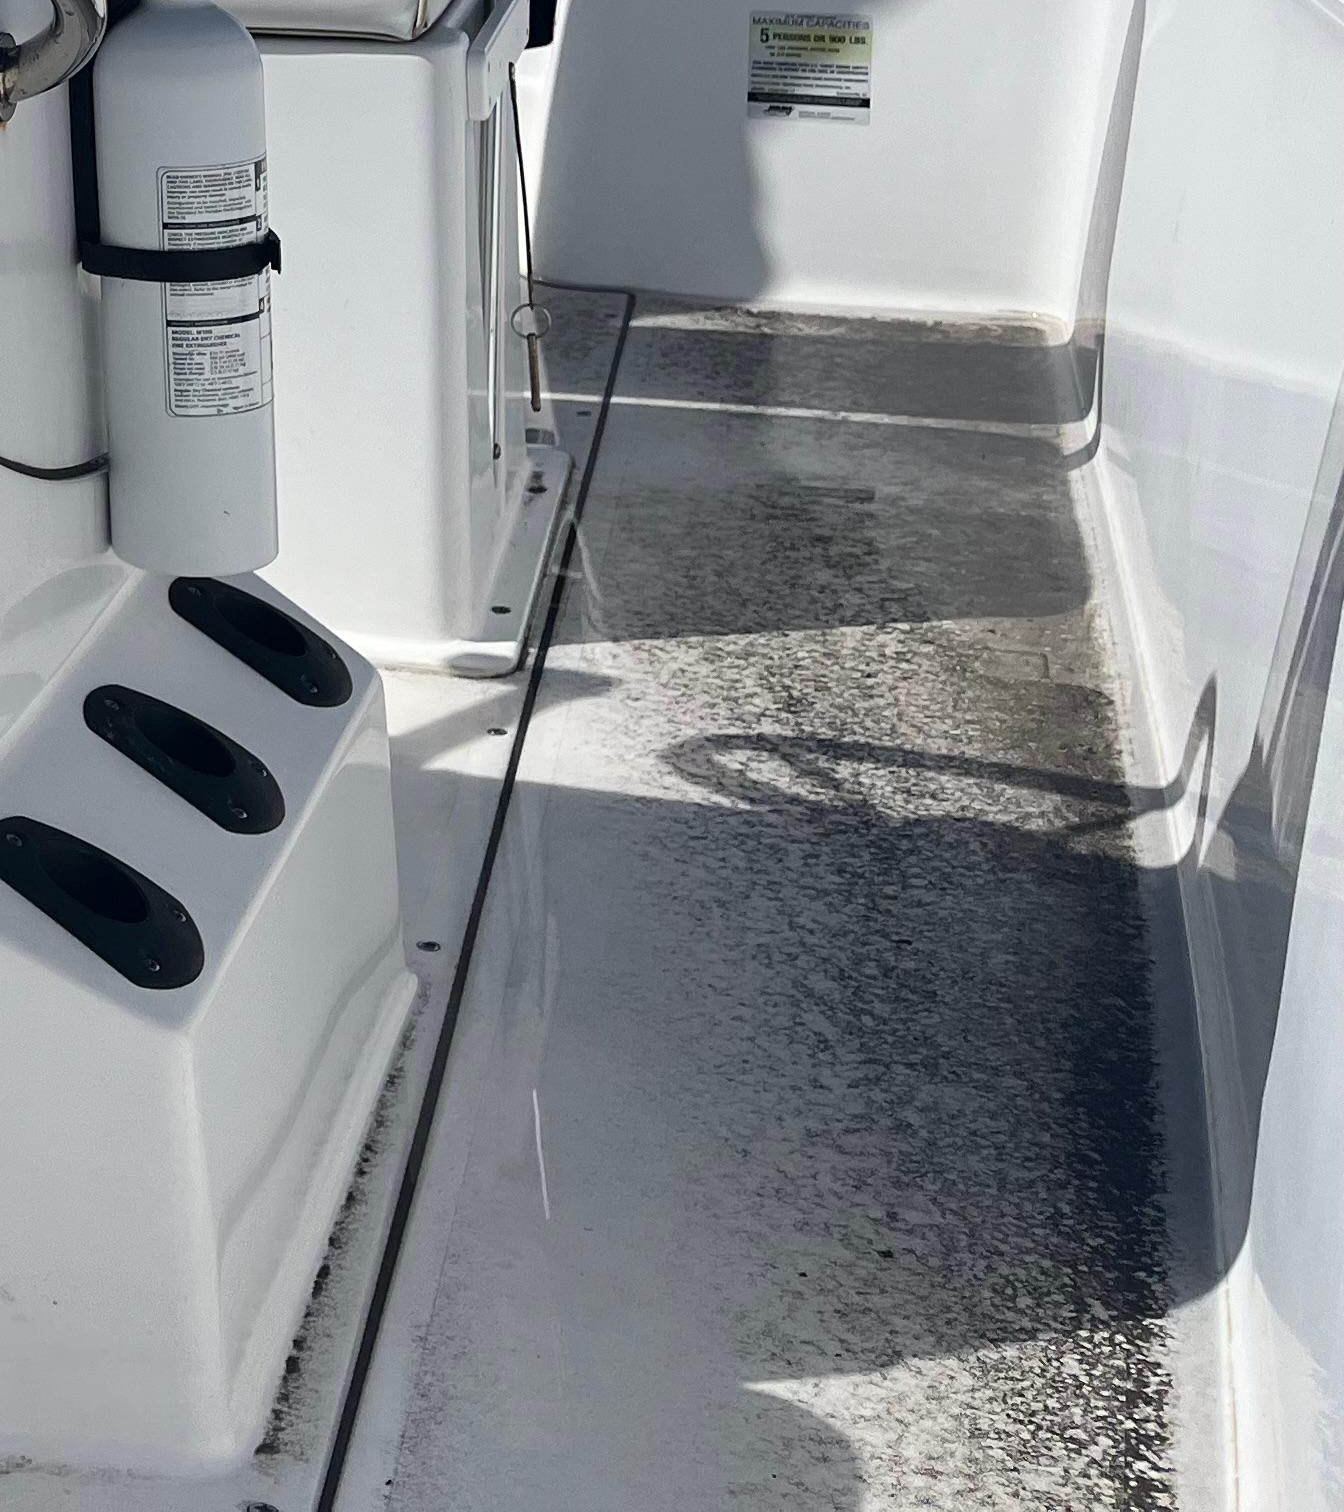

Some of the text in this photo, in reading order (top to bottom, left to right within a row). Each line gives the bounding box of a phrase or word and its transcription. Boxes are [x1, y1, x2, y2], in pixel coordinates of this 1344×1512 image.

[752, 16, 805, 27] MAXIMUM
[760, 28, 770, 43] 5
[773, 32, 812, 42] PERSONS
